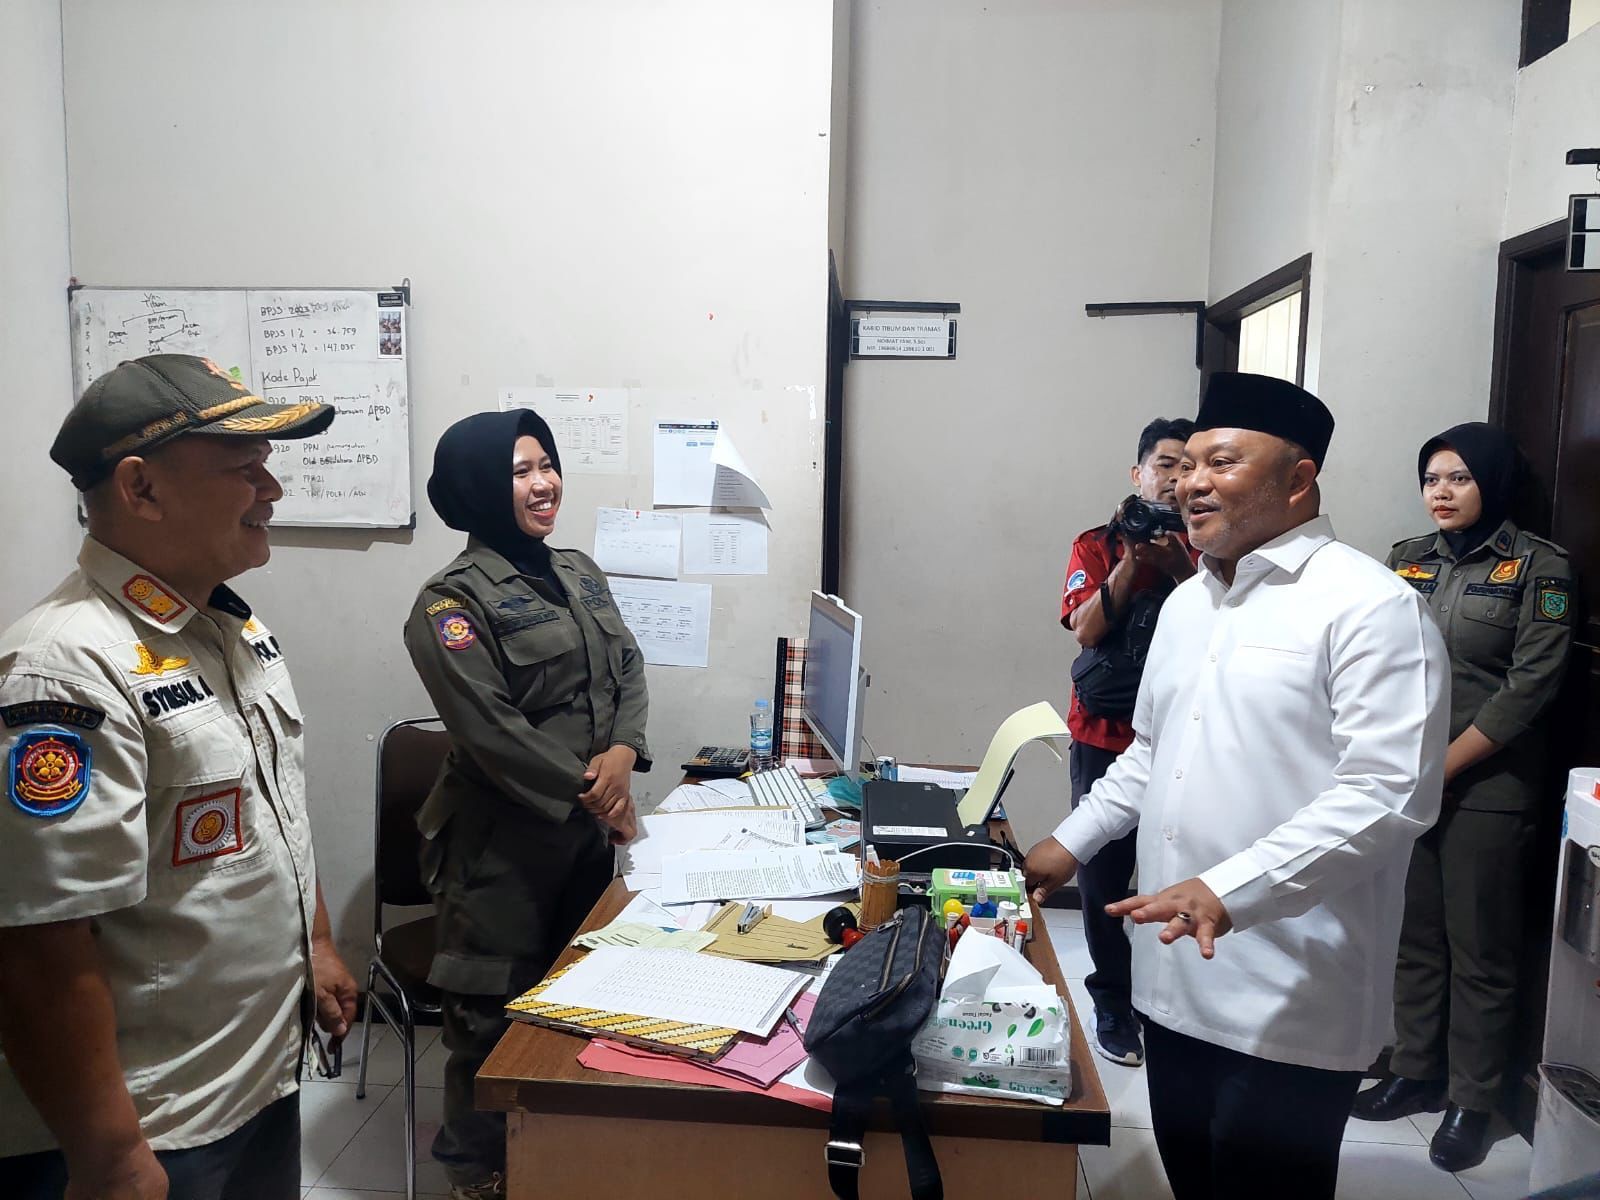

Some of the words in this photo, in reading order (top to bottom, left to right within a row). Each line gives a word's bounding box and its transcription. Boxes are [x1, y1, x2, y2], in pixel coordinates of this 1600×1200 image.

[260, 305, 283, 316] BPJS
[264, 328, 286, 338] BPJS
[266, 345, 288, 356] BPJS
[262, 370, 289, 384] Kode
[293, 368, 318, 387] Pajak
[368, 404, 391, 419] APBD
[357, 454, 379, 464] APBD
